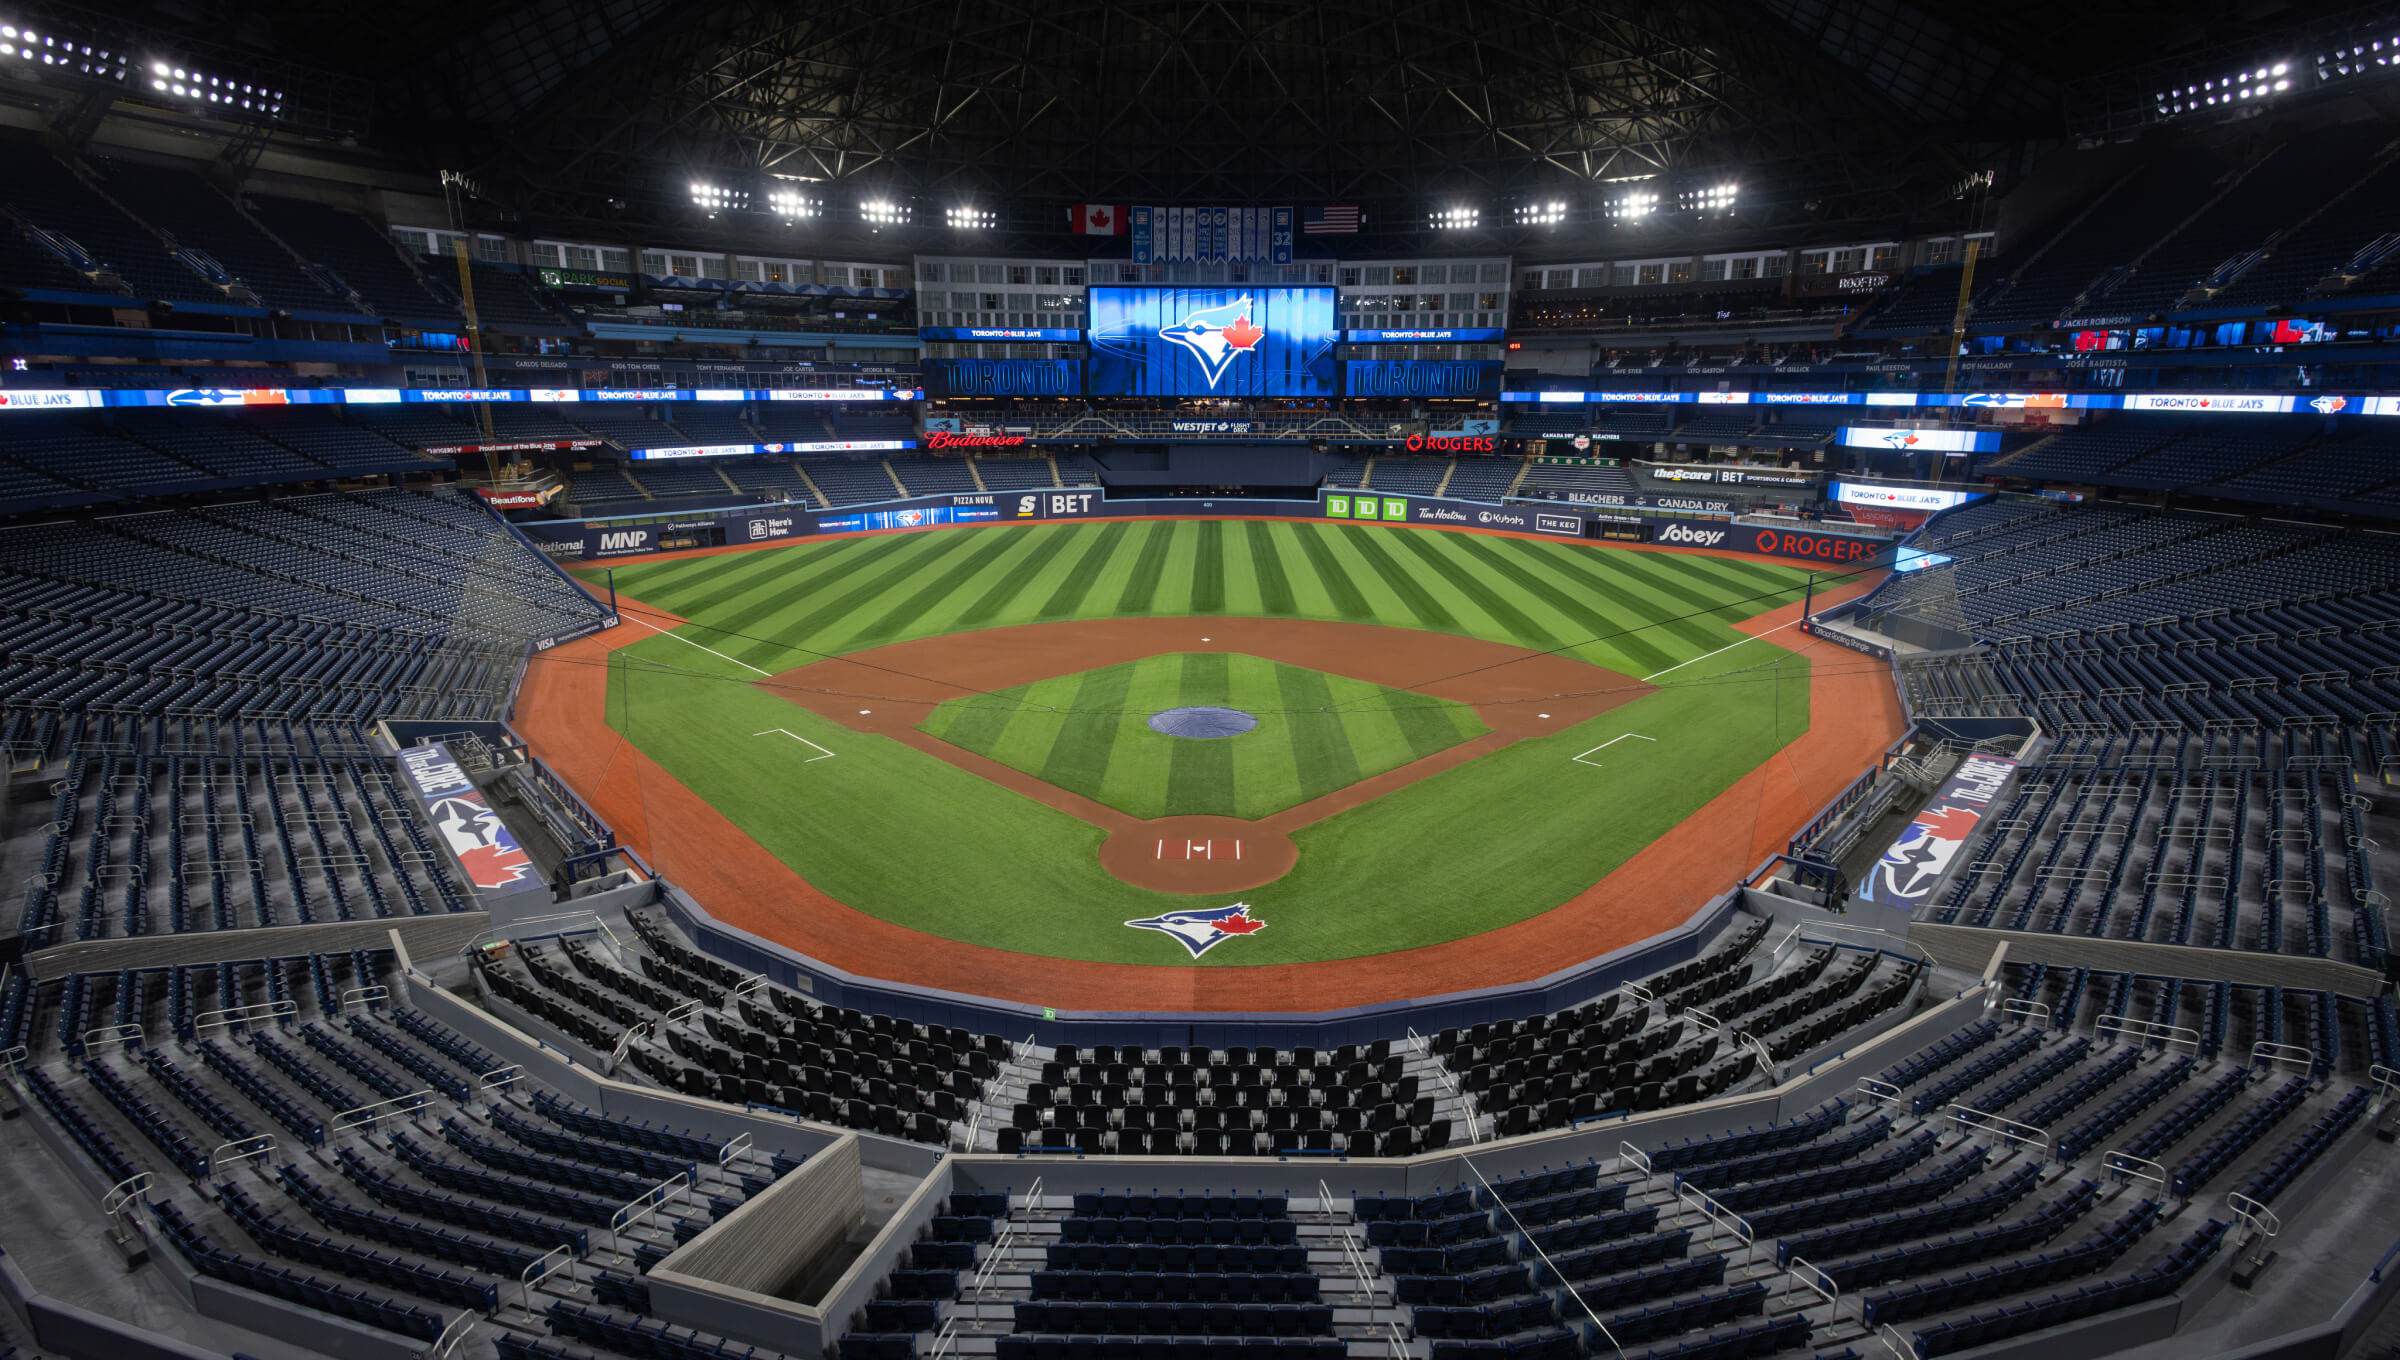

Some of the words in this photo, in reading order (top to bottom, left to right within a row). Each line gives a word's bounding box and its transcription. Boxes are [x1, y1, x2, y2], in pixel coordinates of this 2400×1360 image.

[1273, 231, 1291, 246] 32
[563, 273, 596, 284] PARK
[596, 277, 630, 288] SOCIAL
[1839, 275, 1889, 289] ROOFTOP
[2063, 319, 2088, 328] JACKIE
[2090, 317, 2131, 326] ROBINSON
[541, 361, 567, 369] DELGADO
[944, 360, 1068, 394] TORONTO
[1354, 361, 1480, 395] TORONTO
[10, 394, 40, 406] BLUE
[43, 394, 72, 405] JAYS
[422, 391, 464, 400] TORONTO
[472, 391, 490, 400] BLUE
[491, 391, 510, 399] JAYS
[660, 392, 676, 400] JAYS
[1767, 394, 1802, 402] TORONTO
[1811, 395, 1829, 403] BLUE
[1829, 395, 1848, 403] JAYS
[2150, 398, 2198, 408] TORONTO
[2211, 399, 2235, 409] BLUE
[2237, 399, 2264, 409] JAYS
[1172, 422, 1217, 434] WESTJET
[924, 431, 1025, 449] Budweiser
[1426, 437, 1493, 451] ROGERS
[1653, 468, 1711, 480] theScore
[1721, 471, 1745, 482] BET
[954, 496, 973, 505] PIZZA
[975, 495, 994, 504] NOVA
[1052, 495, 1092, 513] BET
[1568, 492, 1625, 505] BLEACHERS
[1657, 498, 1702, 510] CANADA
[1851, 490, 1887, 500] TORONTO
[1896, 494, 1918, 502] BLUE
[1919, 496, 1941, 504] JAYS
[1329, 499, 1346, 513] TD
[1357, 501, 1375, 515] TD
[1386, 502, 1404, 516] TD
[1418, 508, 1434, 519] Tim
[1435, 508, 1467, 521] Hortons
[1493, 512, 1524, 525] Kubota
[768, 517, 793, 528] Here's
[1541, 519, 1558, 527] THE
[1559, 520, 1576, 529] KEG
[769, 526, 789, 536] How.
[1659, 523, 1725, 546] Sobeys
[536, 539, 584, 552] National
[601, 531, 648, 550] MNP
[1783, 534, 1879, 562] ROGERS
[602, 617, 619, 629] VISA
[536, 638, 555, 651] VISA
[1814, 626, 1831, 637] Official
[1850, 638, 1871, 652] Shingle
[403, 748, 440, 762] TO
[411, 762, 471, 793] CORE
[1957, 757, 2015, 786] CORE
[1950, 787, 1993, 803] TO
